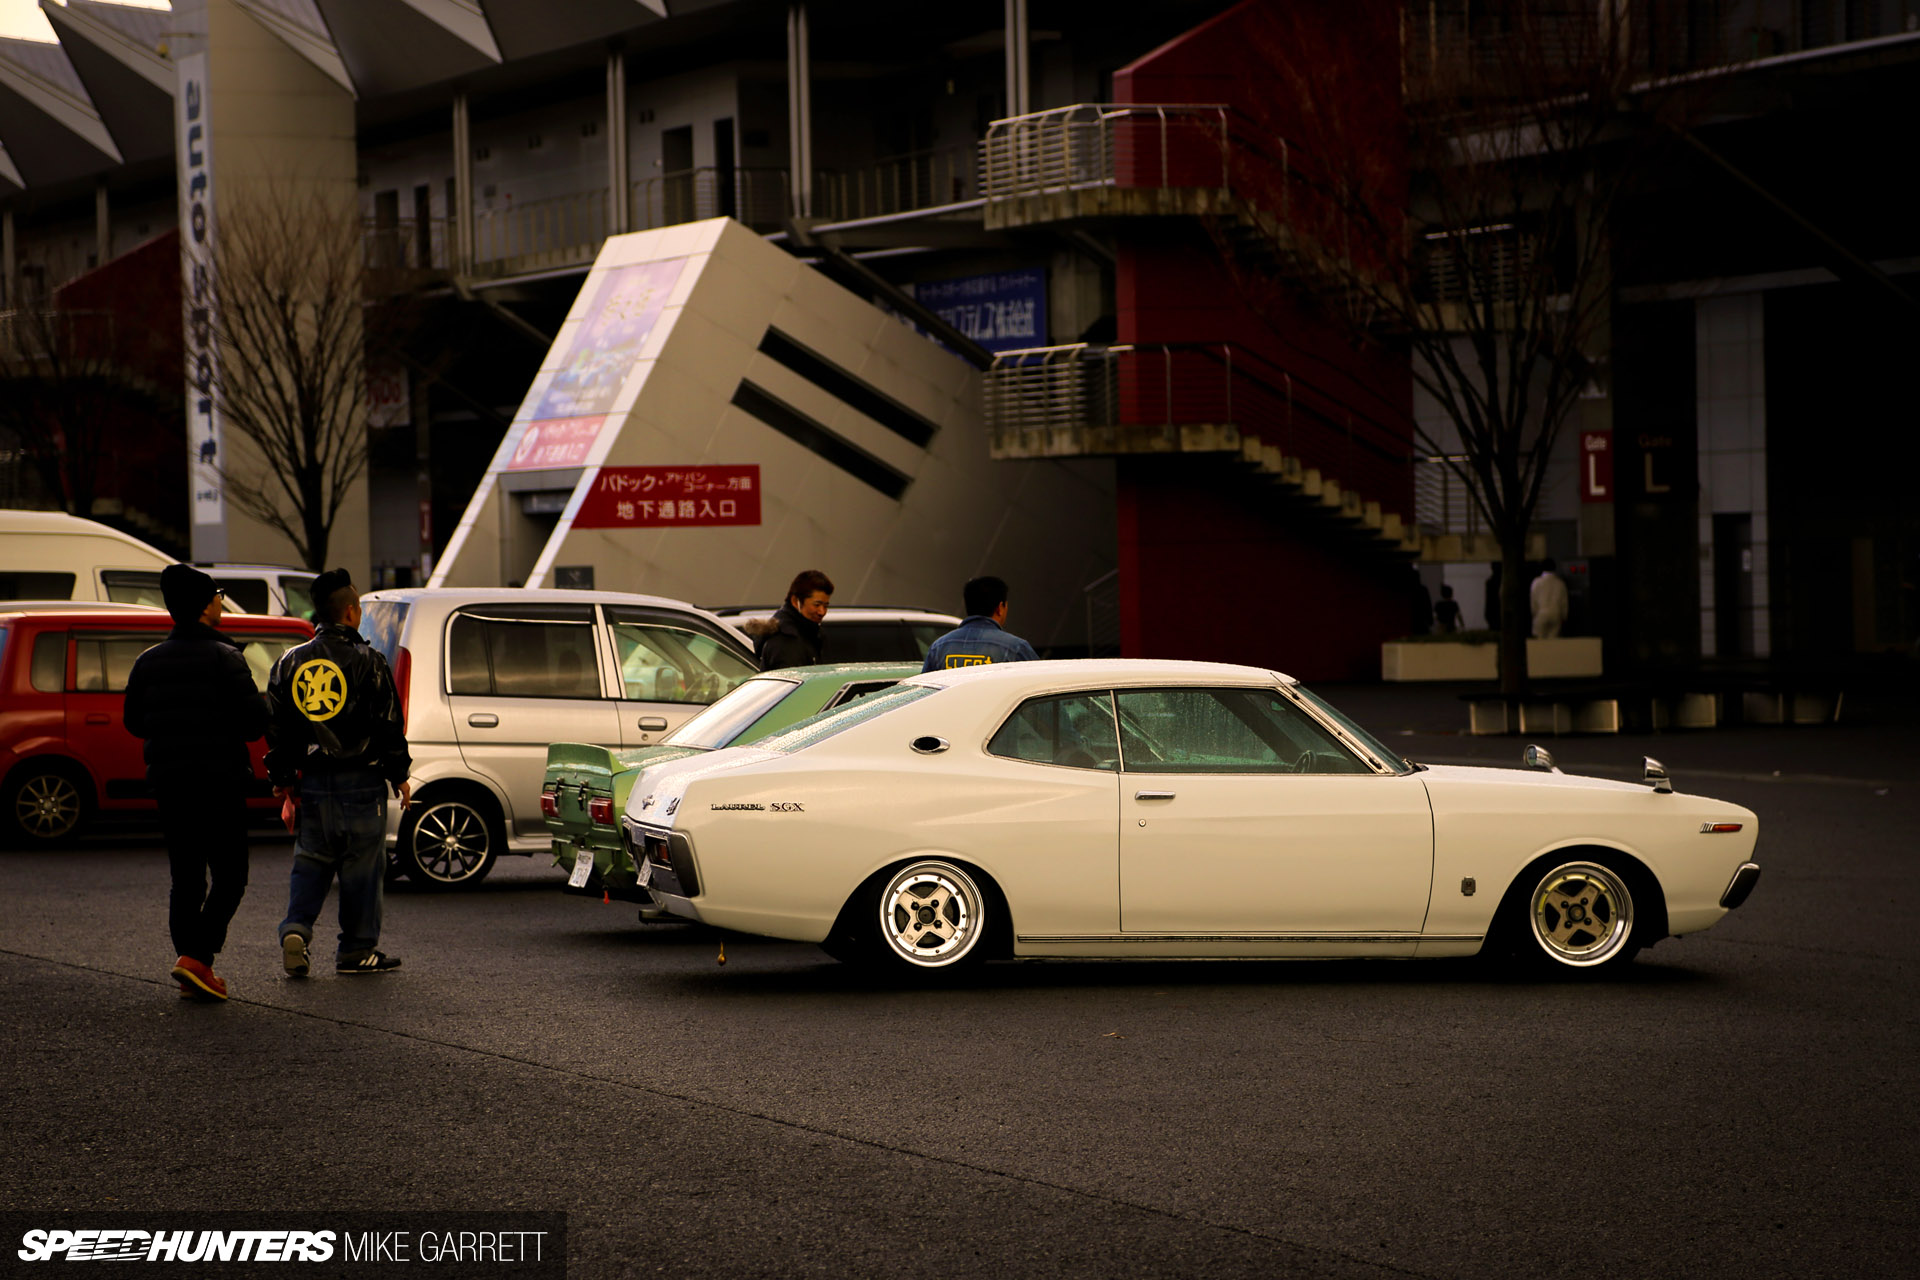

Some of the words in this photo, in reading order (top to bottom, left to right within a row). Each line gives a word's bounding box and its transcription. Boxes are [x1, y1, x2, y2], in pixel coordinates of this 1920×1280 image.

[1588, 452, 1607, 496] L
[1643, 451, 1672, 494] L
[616, 499, 736, 520] 地下通路入口
[711, 803, 765, 811] LAUREL
[770, 802, 805, 812] SGX
